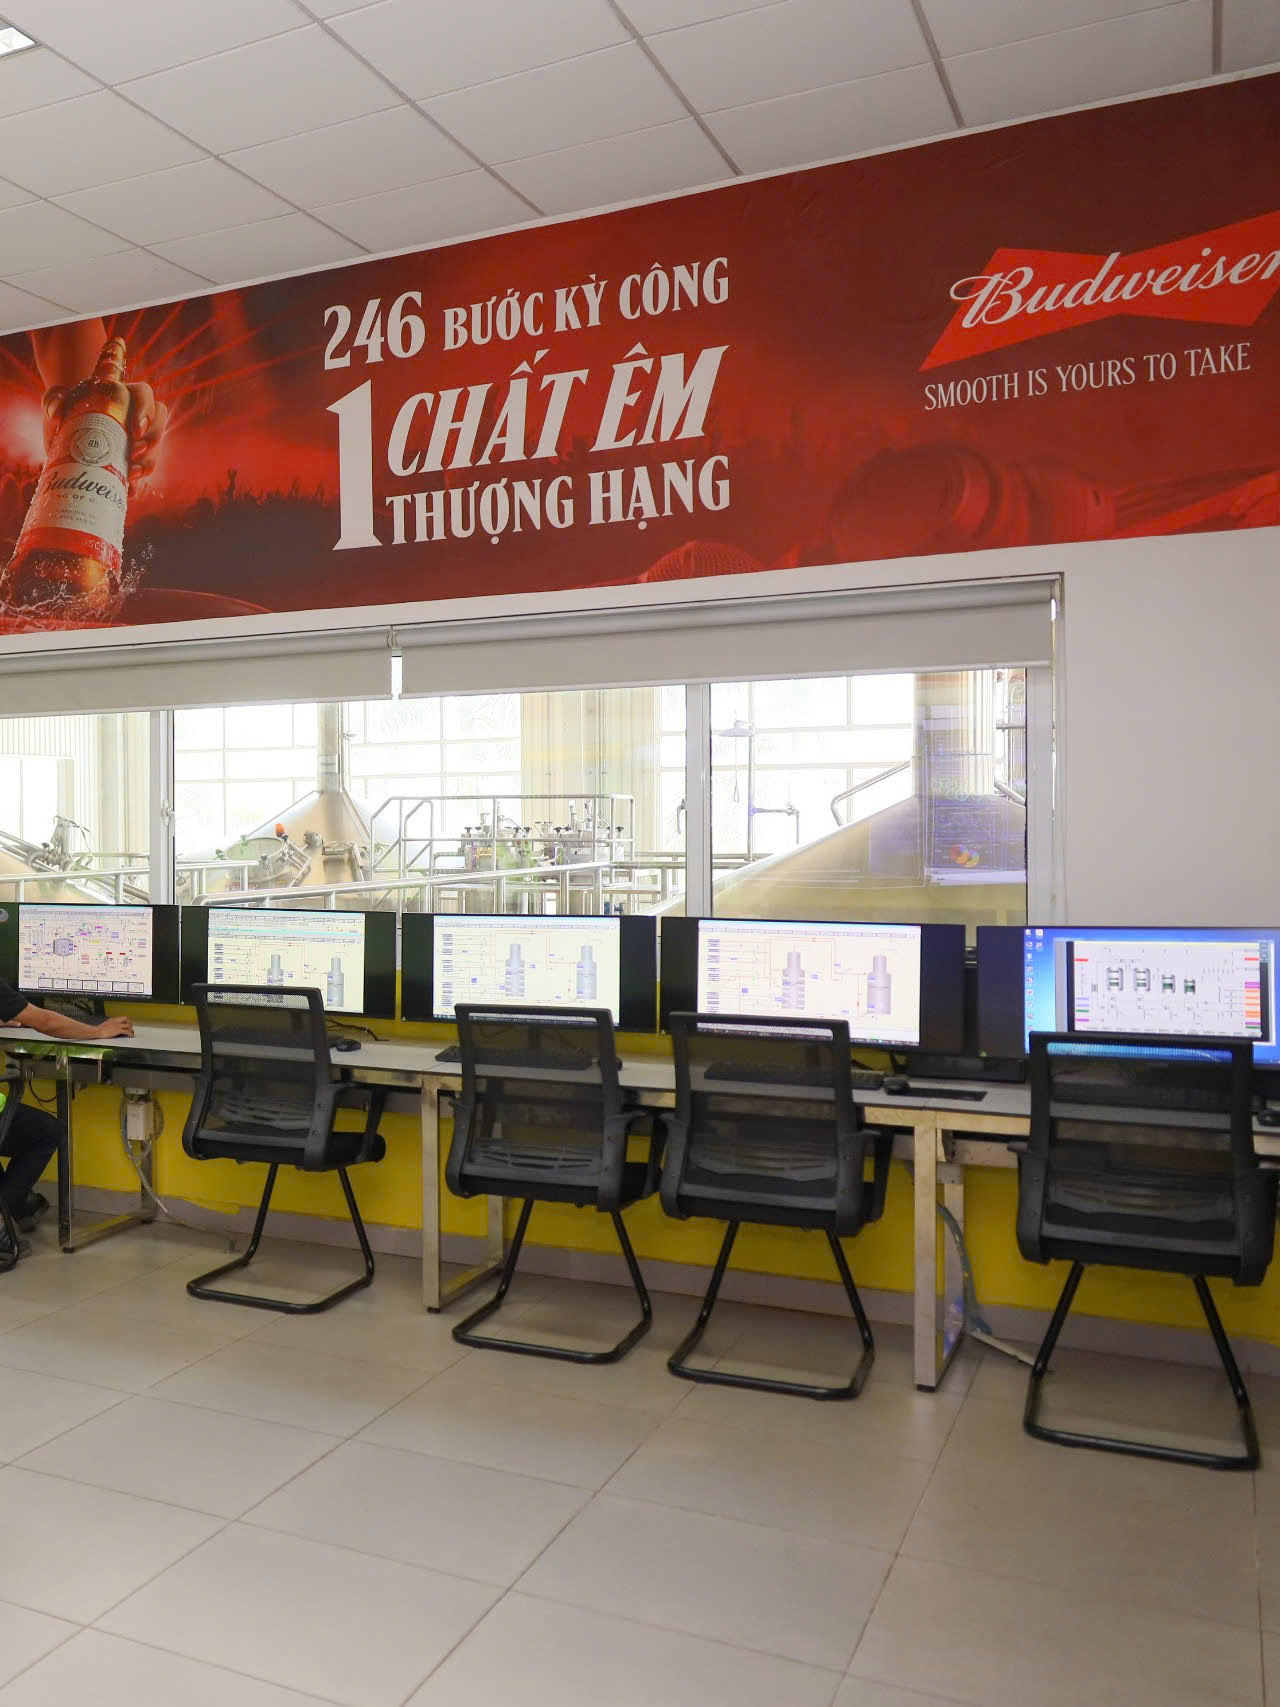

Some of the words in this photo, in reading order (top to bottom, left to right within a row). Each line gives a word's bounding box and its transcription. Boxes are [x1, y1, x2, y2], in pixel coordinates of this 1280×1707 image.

[323, 291, 426, 371] 246
[443, 288, 544, 351] BƯỚC
[554, 273, 608, 333] KỲ
[619, 257, 730, 320] CÔNG
[949, 247, 1280, 329] Budweiser
[387, 348, 590, 477] CHẤT
[589, 342, 730, 453] ÊM
[924, 372, 1019, 411] SMOOTH
[1027, 368, 1048, 397] IS
[1056, 357, 1136, 392] YOURS
[1143, 352, 1177, 382] TO
[1184, 343, 1251, 377] TAKE
[325, 379, 383, 551] 1
[386, 475, 573, 545] THƯỢNG
[588, 455, 731, 530] HẠNG
